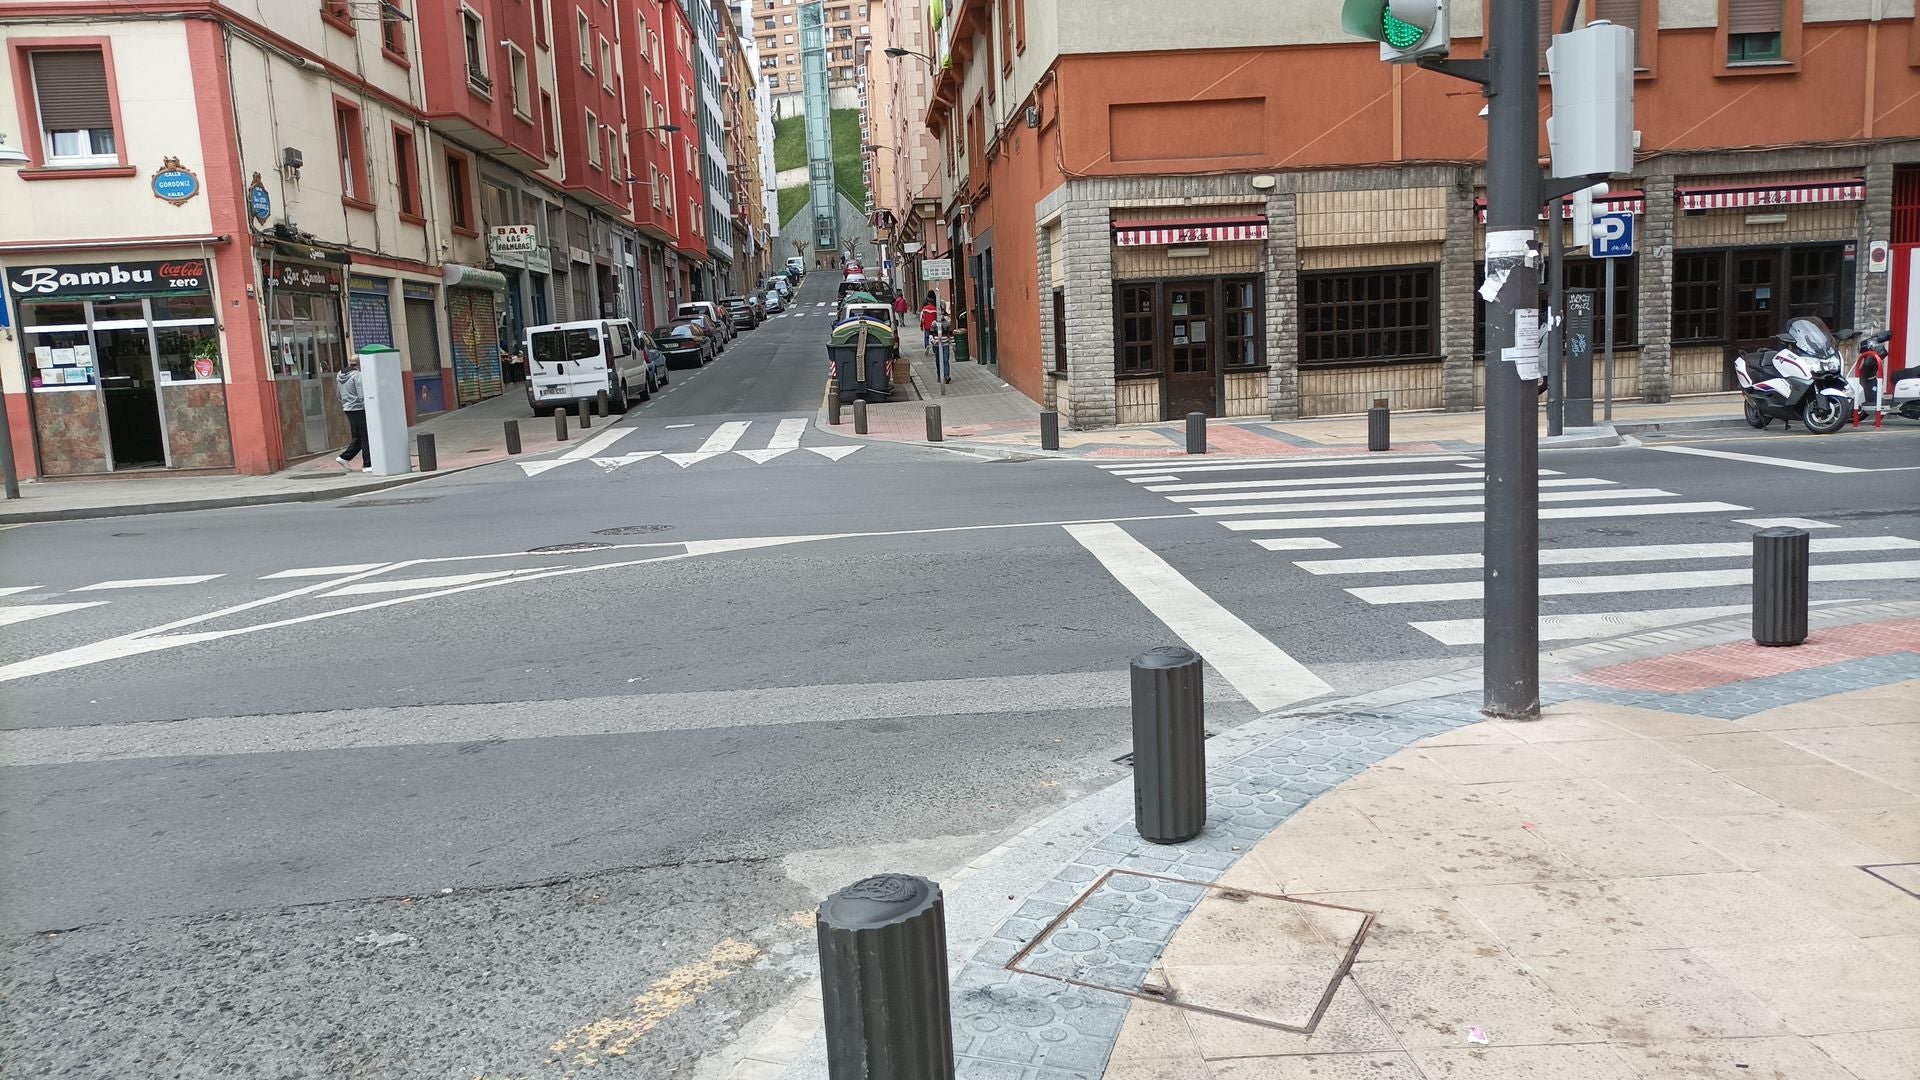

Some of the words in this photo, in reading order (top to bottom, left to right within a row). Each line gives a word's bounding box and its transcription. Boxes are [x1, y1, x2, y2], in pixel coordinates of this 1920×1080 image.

[497, 227, 529, 235] BAR
[1600, 218, 1625, 251] P
[12, 265, 152, 293] Bambu
[169, 278, 198, 287] zero
[283, 266, 299, 285] Bar
[301, 269, 326, 287] Bambu
